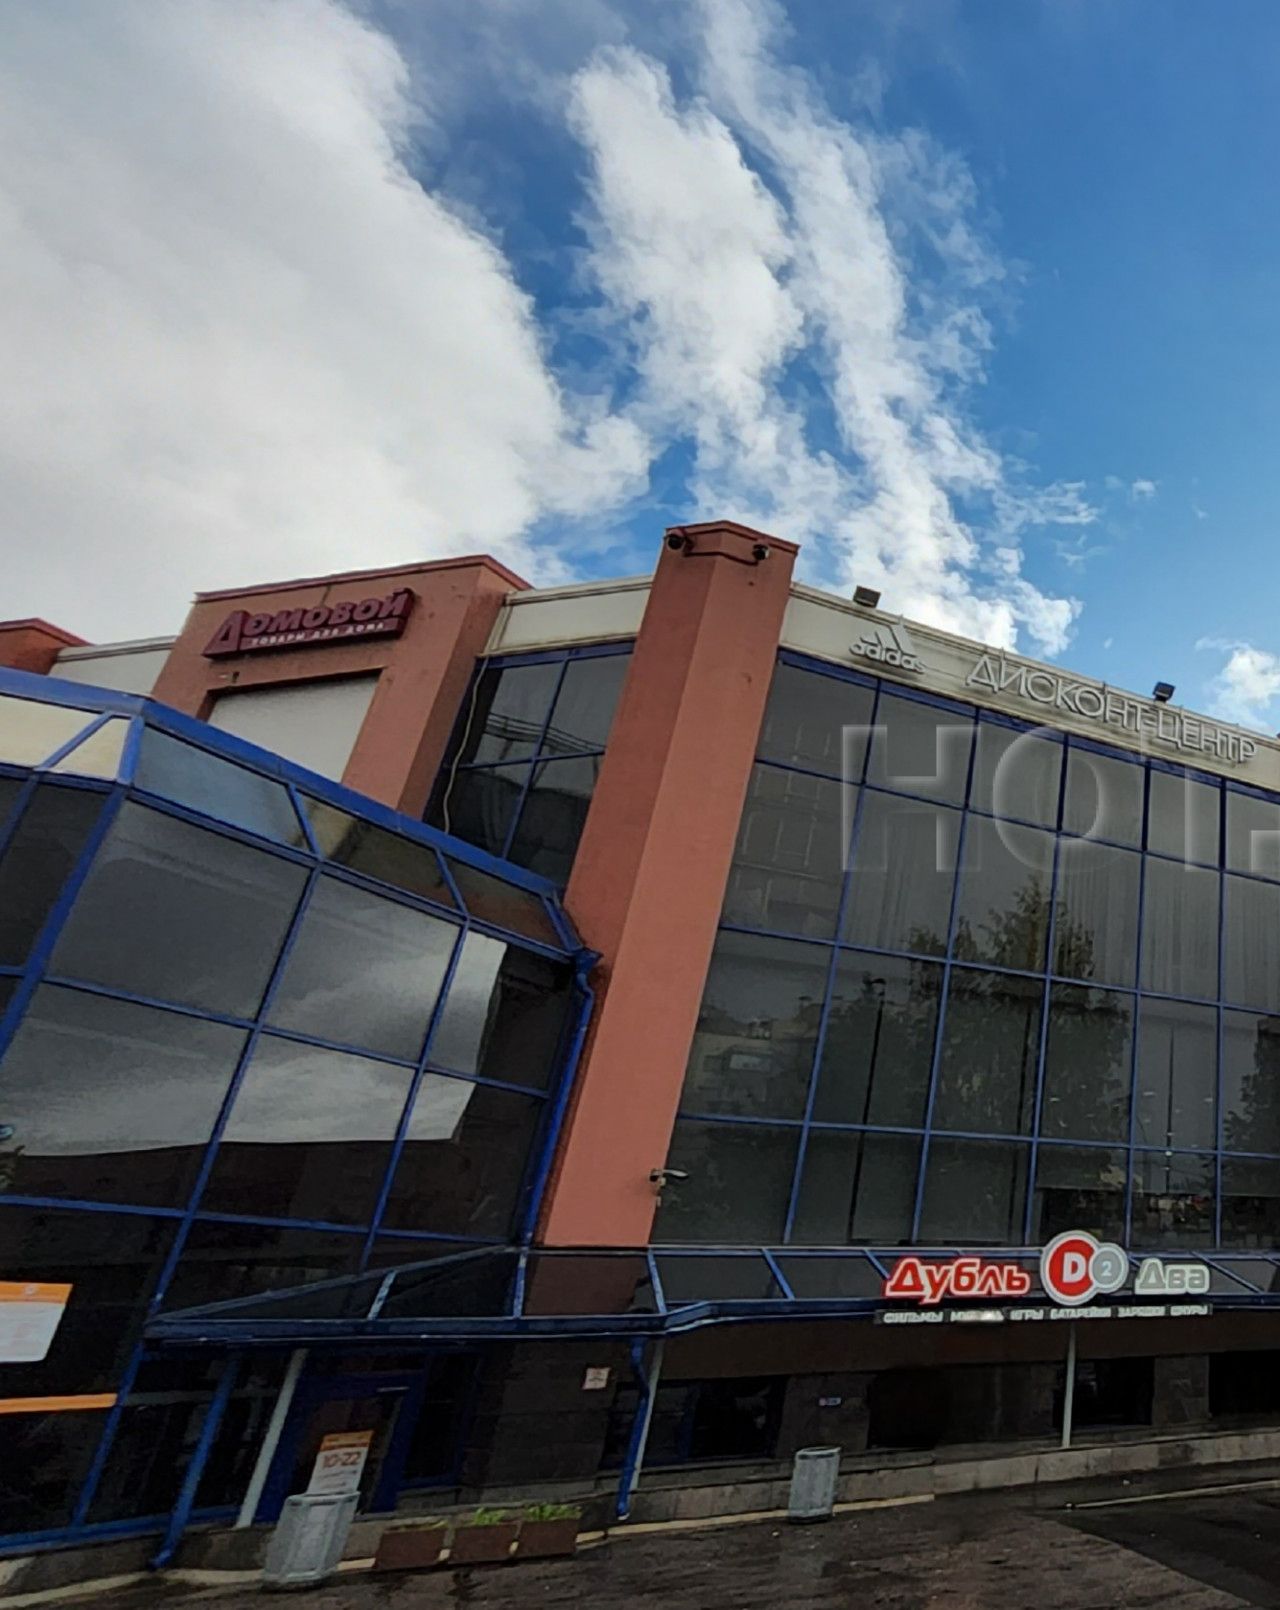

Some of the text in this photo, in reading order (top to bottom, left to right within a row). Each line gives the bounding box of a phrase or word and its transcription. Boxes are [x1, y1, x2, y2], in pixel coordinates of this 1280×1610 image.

[849, 641, 926, 674] adidas
[965, 655, 1257, 763] ДИСКОНТ-ЦЕНТР
[884, 1257, 1030, 1304] Дубль
[1135, 1258, 1210, 1295] Два
